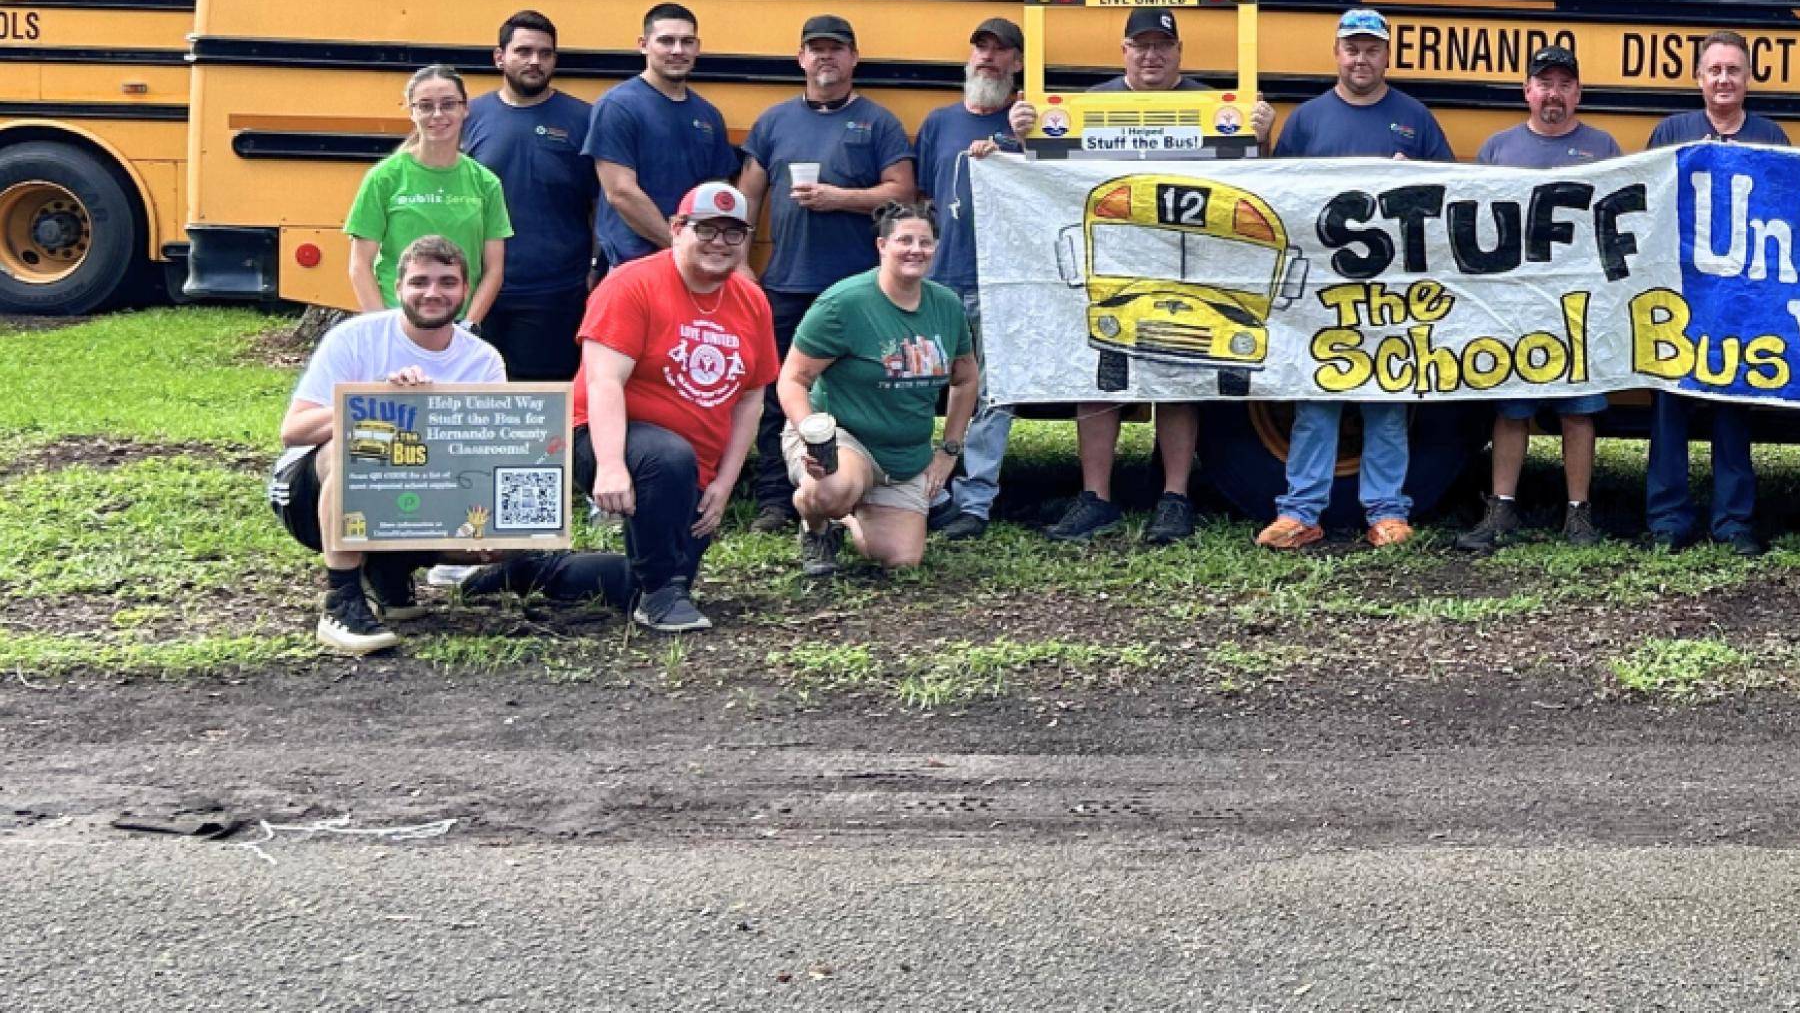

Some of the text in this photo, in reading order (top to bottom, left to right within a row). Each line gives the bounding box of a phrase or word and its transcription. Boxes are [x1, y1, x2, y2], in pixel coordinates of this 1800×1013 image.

[1621, 32, 1798, 83] DISTCT
[1087, 137, 1199, 150] Stuff the Bus!
[1161, 186, 1204, 225] 12
[1316, 181, 1647, 281] STUFF
[1316, 280, 1455, 330] The
[1310, 287, 1790, 398] School Bus
[349, 396, 417, 432] Stuff
[427, 396, 545, 411] Help United Way
[428, 412, 545, 425] Stuff the Bus for
[426, 427, 548, 442] Hernando County
[448, 443, 529, 455] Classrooms!
